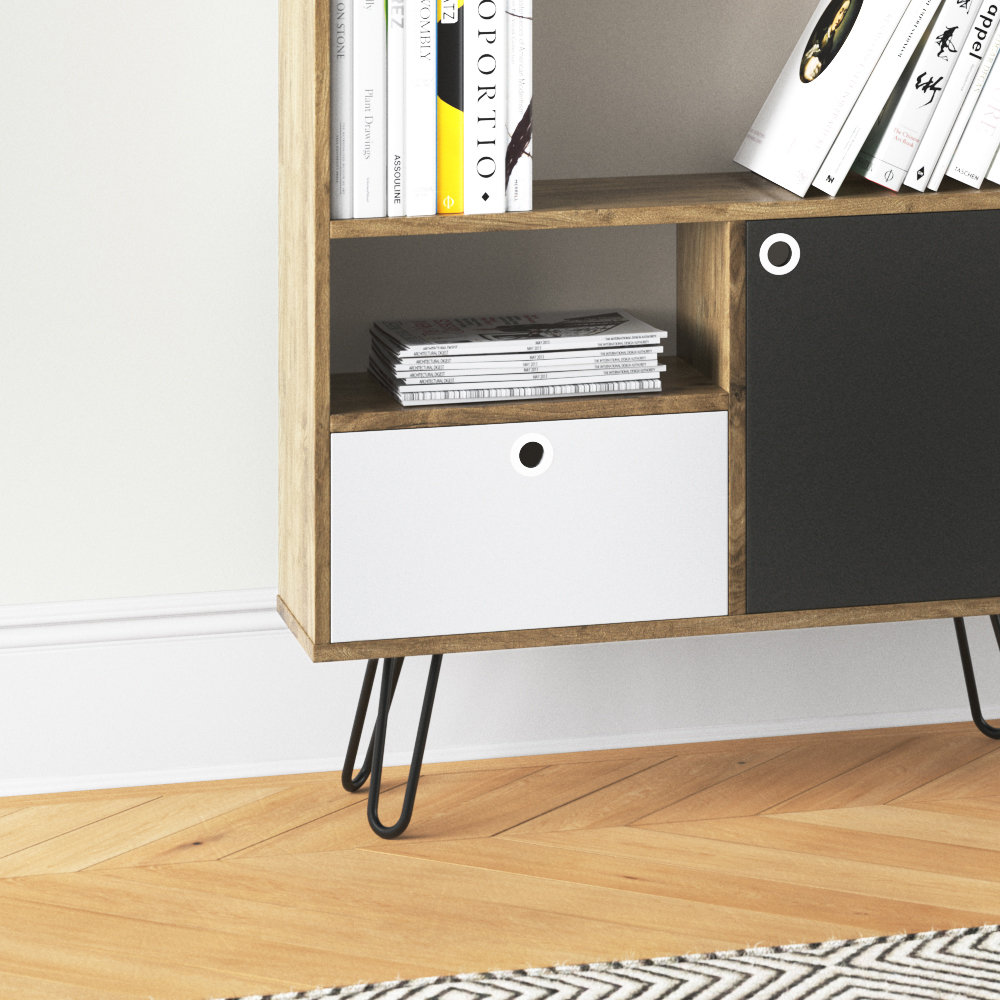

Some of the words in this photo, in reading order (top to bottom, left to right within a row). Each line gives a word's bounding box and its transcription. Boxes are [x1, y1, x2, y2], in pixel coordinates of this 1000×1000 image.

[336, 2, 346, 21] ON
[336, 23, 346, 59] STONE
[969, 4, 998, 60] appel
[364, 89, 374, 112] Plant
[363, 116, 374, 160] Drawings
[393, 154, 401, 204] ASSOULINE
[953, 165, 980, 182] TASCHEN
